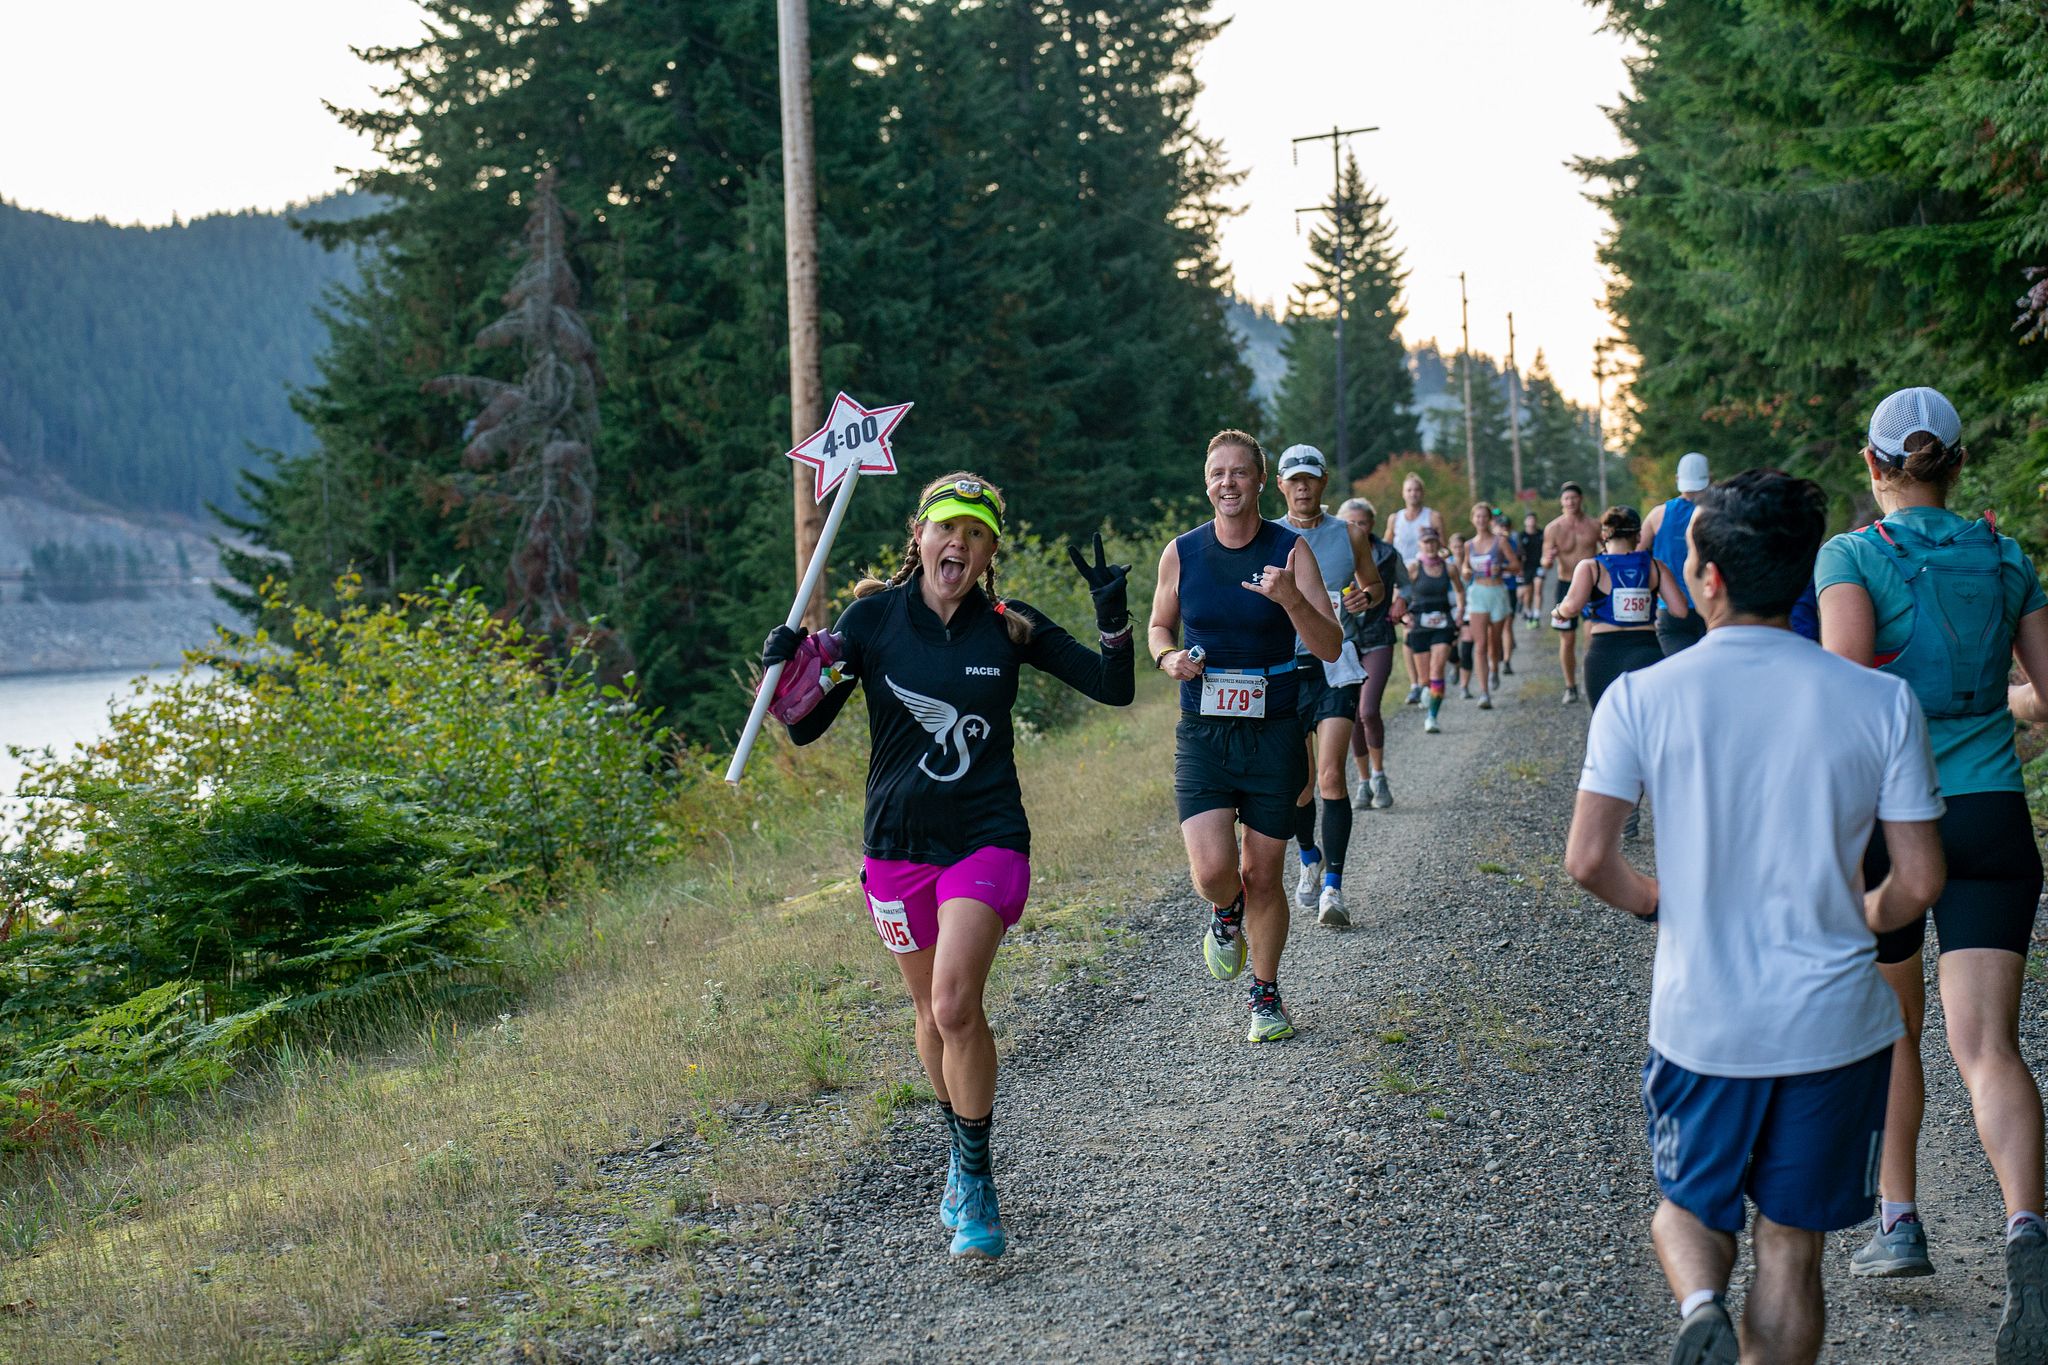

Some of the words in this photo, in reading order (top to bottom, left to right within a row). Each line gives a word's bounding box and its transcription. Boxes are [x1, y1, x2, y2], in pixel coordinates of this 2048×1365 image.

[823, 415, 879, 459] 4:00
[1623, 597, 1645, 611] 258
[965, 666, 1001, 677] PACER
[1216, 688, 1250, 711] 179
